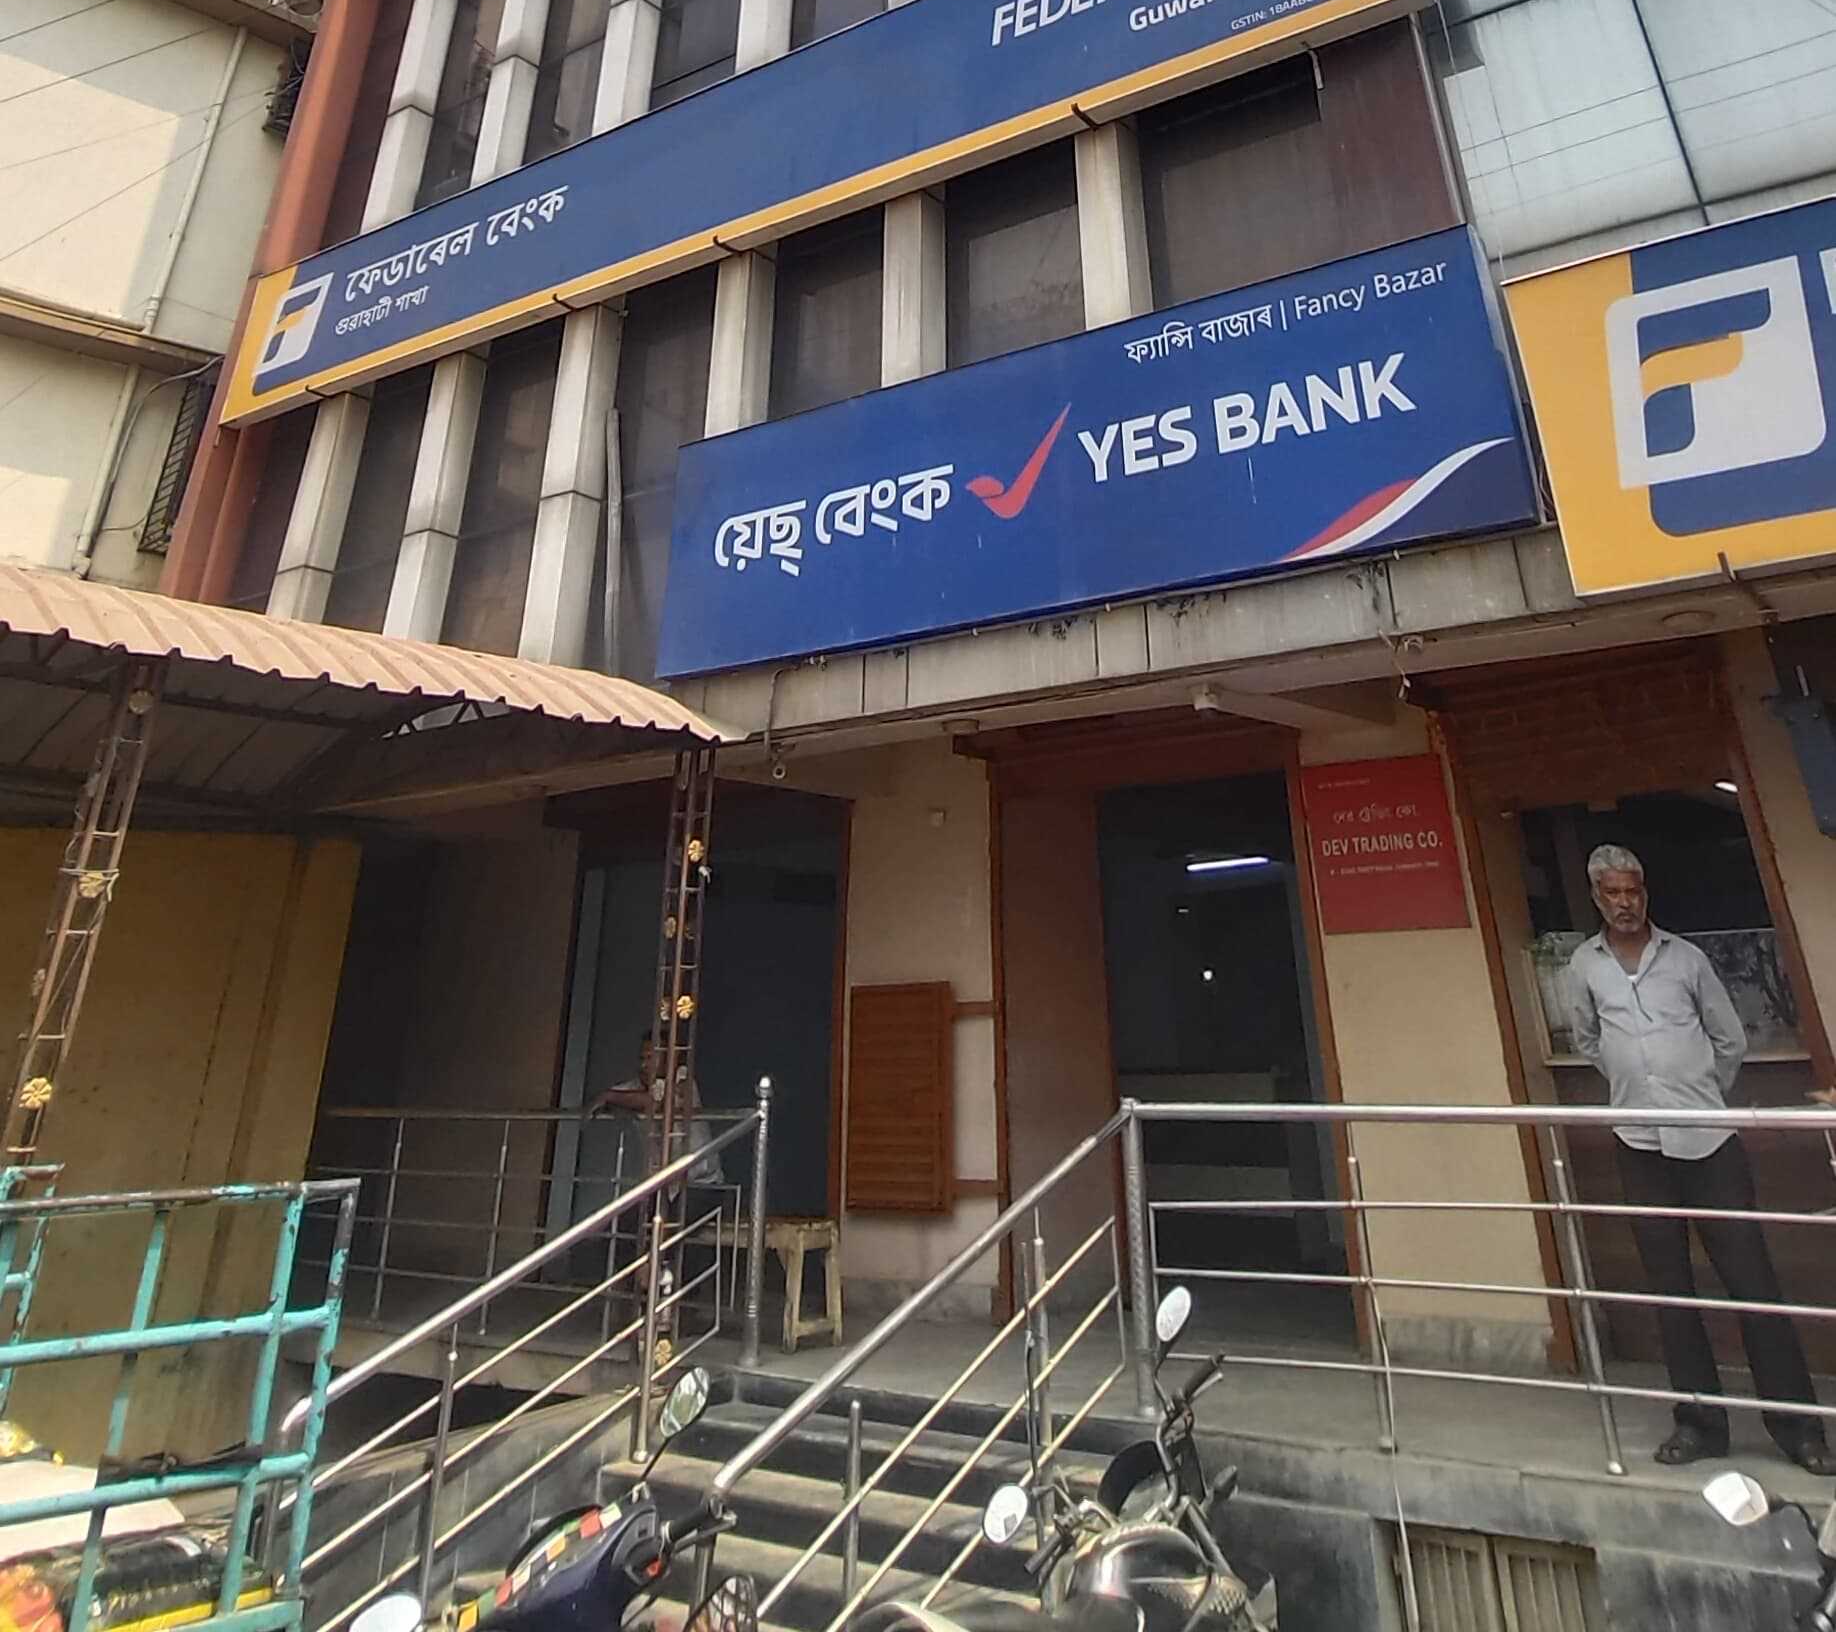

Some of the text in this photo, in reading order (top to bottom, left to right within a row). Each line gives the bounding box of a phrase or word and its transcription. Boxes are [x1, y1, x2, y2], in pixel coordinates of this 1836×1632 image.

[1230, 10, 1268, 31] GSTIN:
[344, 184, 570, 302] ফেডাৰেল বেংক
[1199, 303, 1274, 345] বাজাৰ
[1293, 284, 1366, 322] Fancy
[1372, 262, 1447, 299] Bazar
[1078, 351, 1418, 485] YES BANK
[814, 463, 954, 545] বেংক
[1322, 830, 1443, 857] DEV TRADING CO.
